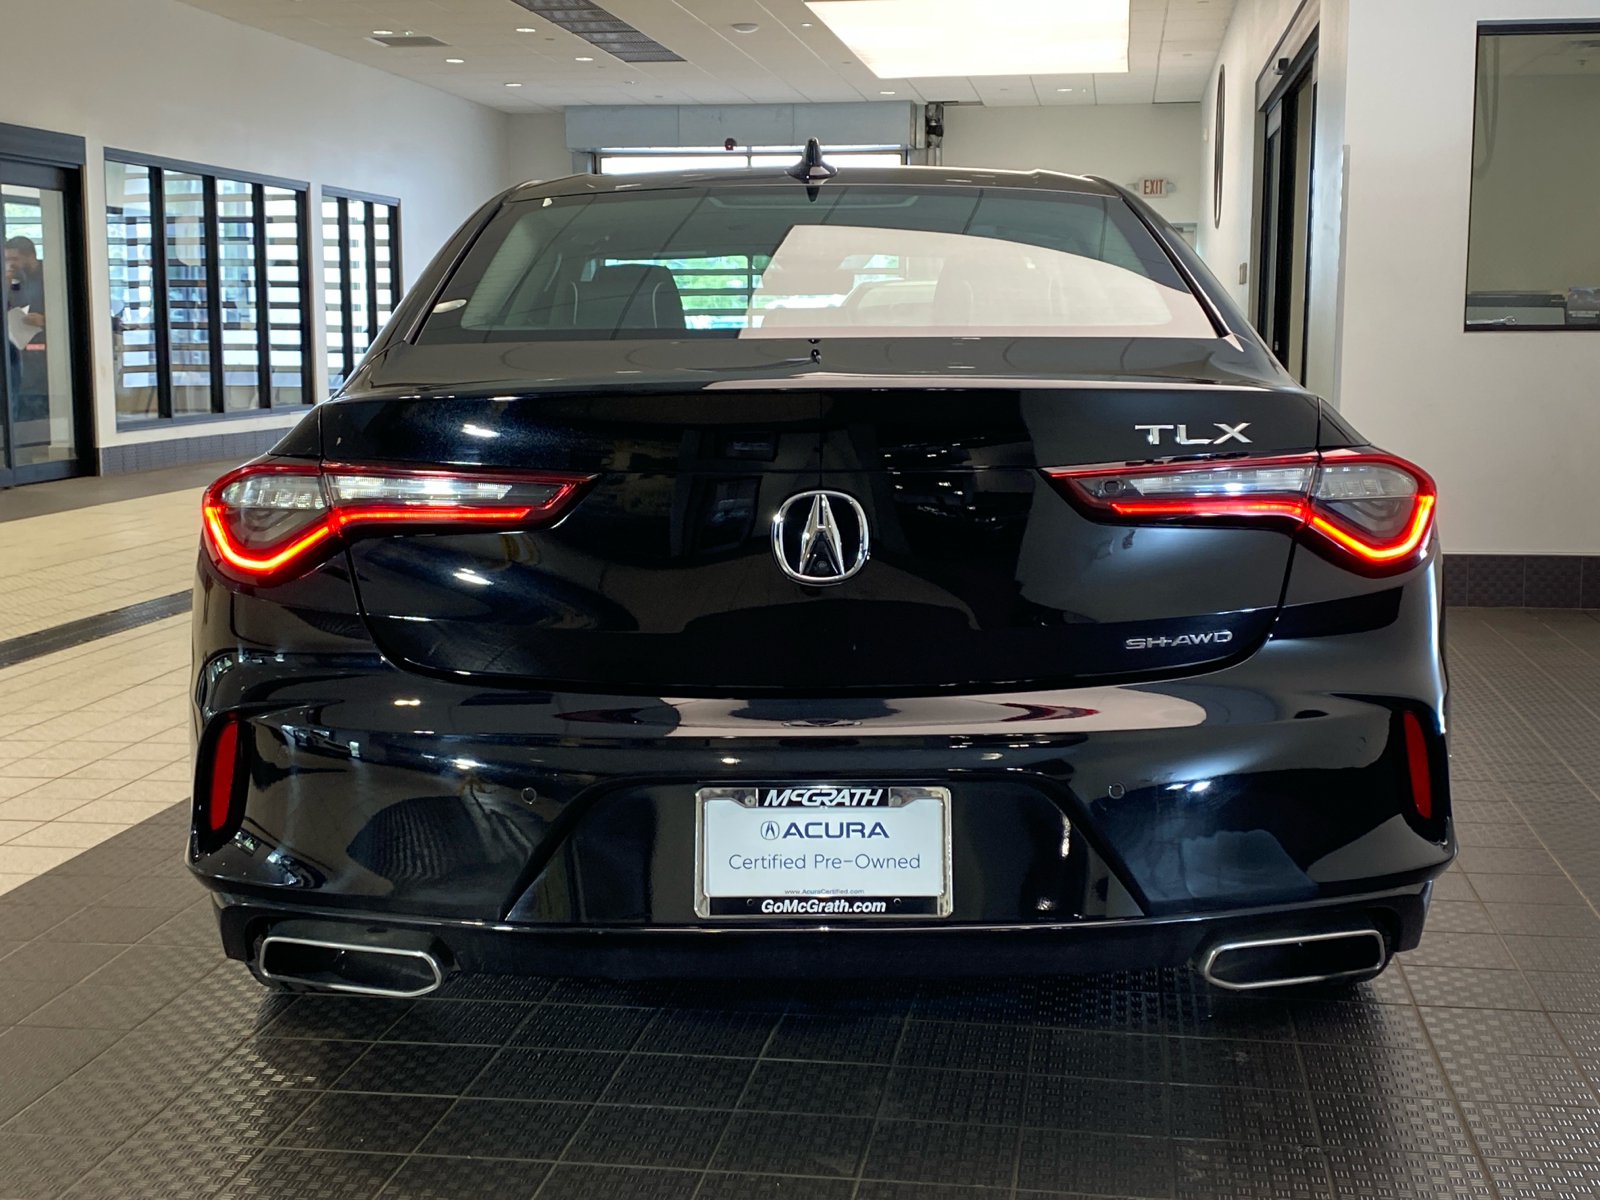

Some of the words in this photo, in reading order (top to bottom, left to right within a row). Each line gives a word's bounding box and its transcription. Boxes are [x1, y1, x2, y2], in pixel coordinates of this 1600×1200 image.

[1143, 179, 1164, 195] EXIT
[1134, 421, 1253, 446] TLX
[1125, 629, 1233, 650] SH-AWD
[781, 821, 890, 839] ACURA
[728, 854, 806, 870] Certified
[813, 853, 921, 870] Pre-Owned
[760, 898, 887, 914] GoMcGrath.com
